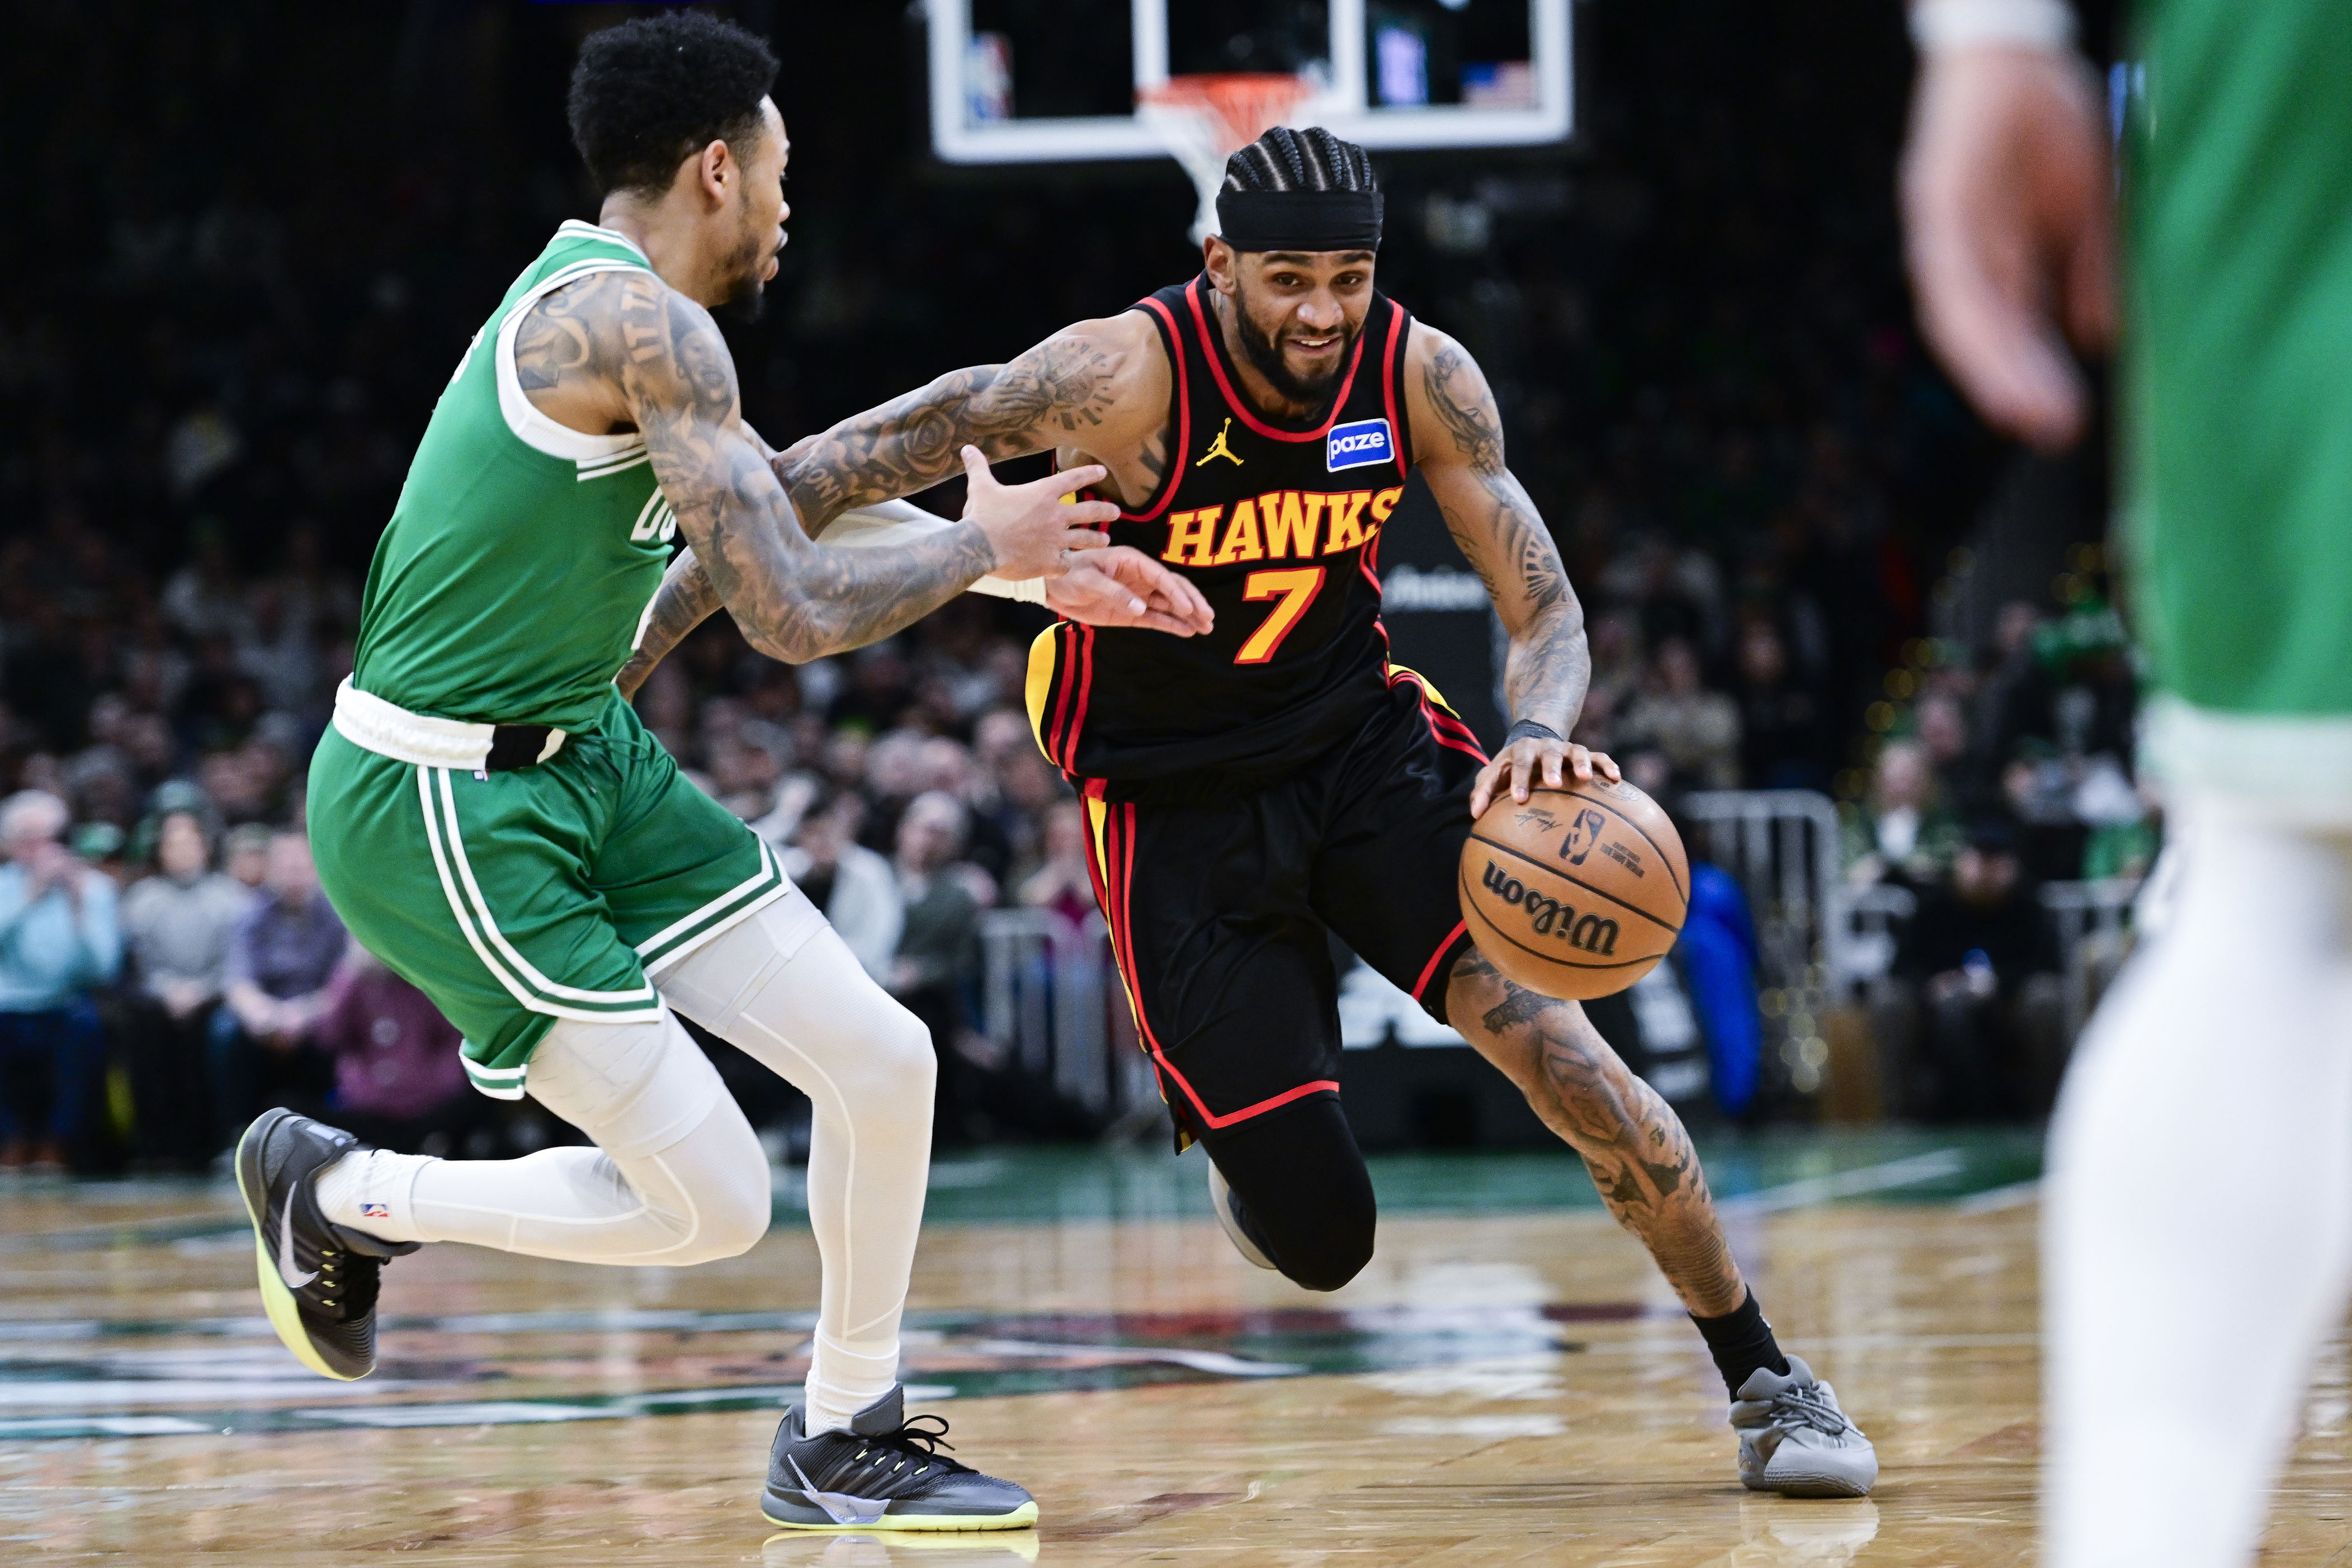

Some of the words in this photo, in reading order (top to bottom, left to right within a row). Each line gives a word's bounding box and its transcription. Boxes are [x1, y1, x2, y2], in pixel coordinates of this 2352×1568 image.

[1330, 431, 1385, 461] paze
[1160, 484, 1405, 566] HAWKS
[1233, 565, 1327, 664] 7
[1482, 859, 1621, 956] Wilson
